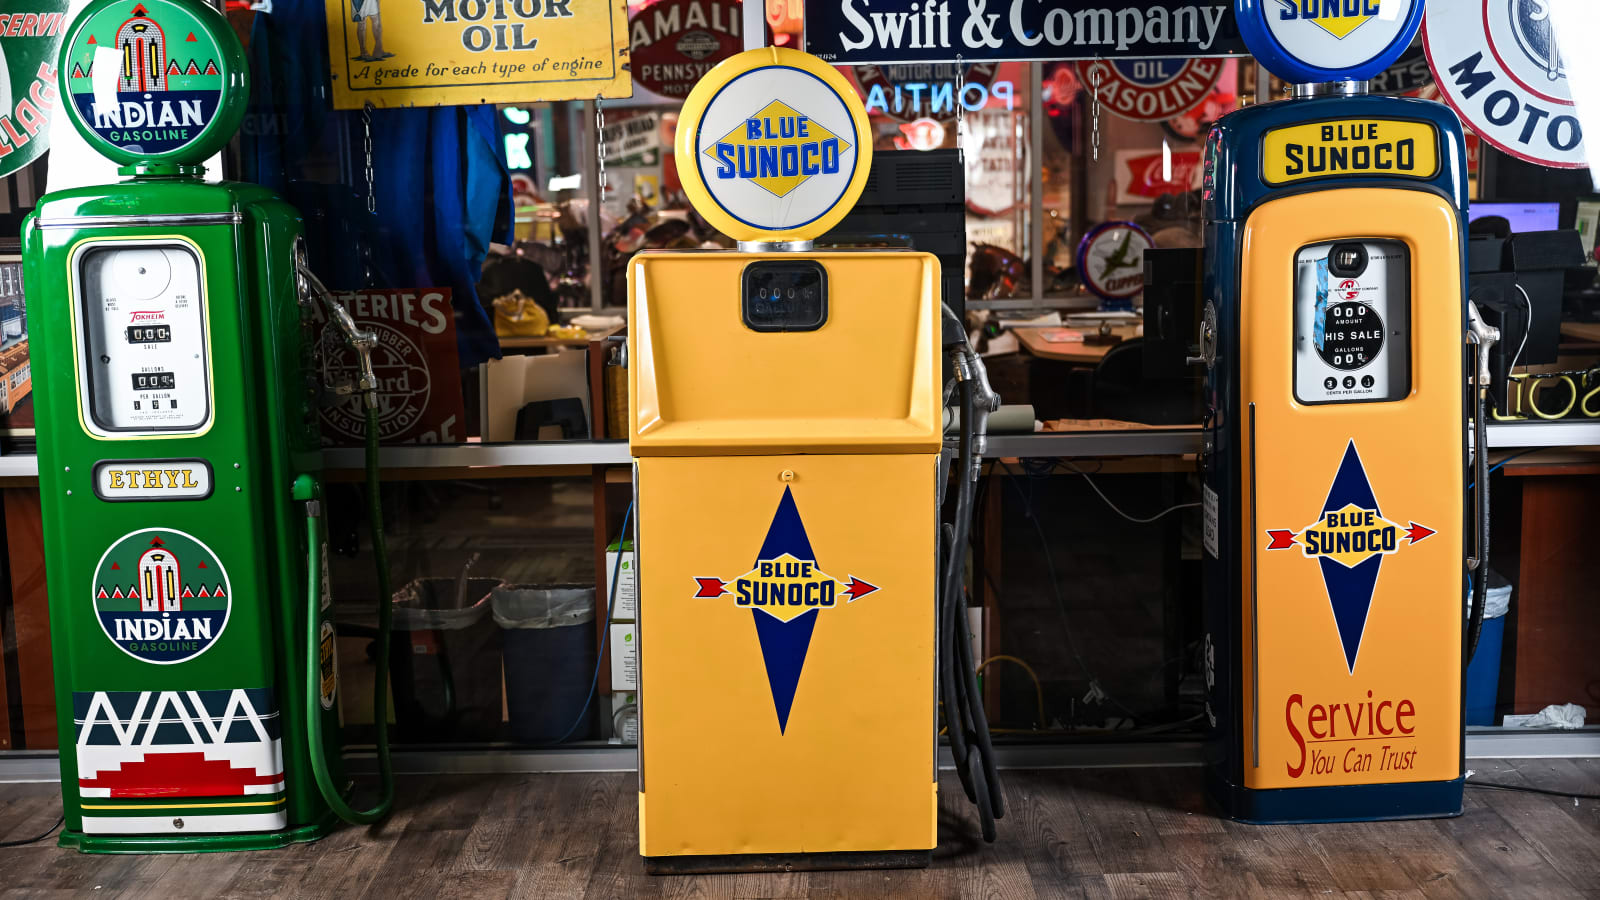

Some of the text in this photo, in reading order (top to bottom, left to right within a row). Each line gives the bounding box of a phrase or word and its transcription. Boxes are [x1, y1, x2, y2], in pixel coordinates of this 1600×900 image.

[422, 0, 575, 25] MOTOR
[460, 23, 540, 53] OIL
[838, 0, 951, 52] Swift
[961, 0, 1004, 49] &
[1009, 0, 1227, 50] Company
[353, 57, 604, 85] A grade for each type of engine
[1133, 61, 1169, 79] OIL
[1086, 58, 1217, 115] GASOLINE
[110, 129, 189, 142] GASOLINE
[746, 116, 809, 140] BLUE
[1321, 123, 1379, 142] BLUE
[716, 138, 840, 179] SUNOCO
[1285, 138, 1415, 175] SUNOCO
[1350, 330, 1381, 340] SALE
[108, 469, 198, 489] ETHYL
[1326, 511, 1375, 528] BLUE
[1305, 526, 1396, 555] SUNOCO
[760, 562, 812, 578] BLUE
[736, 578, 835, 606] SUNOCO
[129, 642, 199, 651] GASOLINE
[1285, 689, 1416, 779] Service
[1310, 745, 1417, 775] You Can Trust
